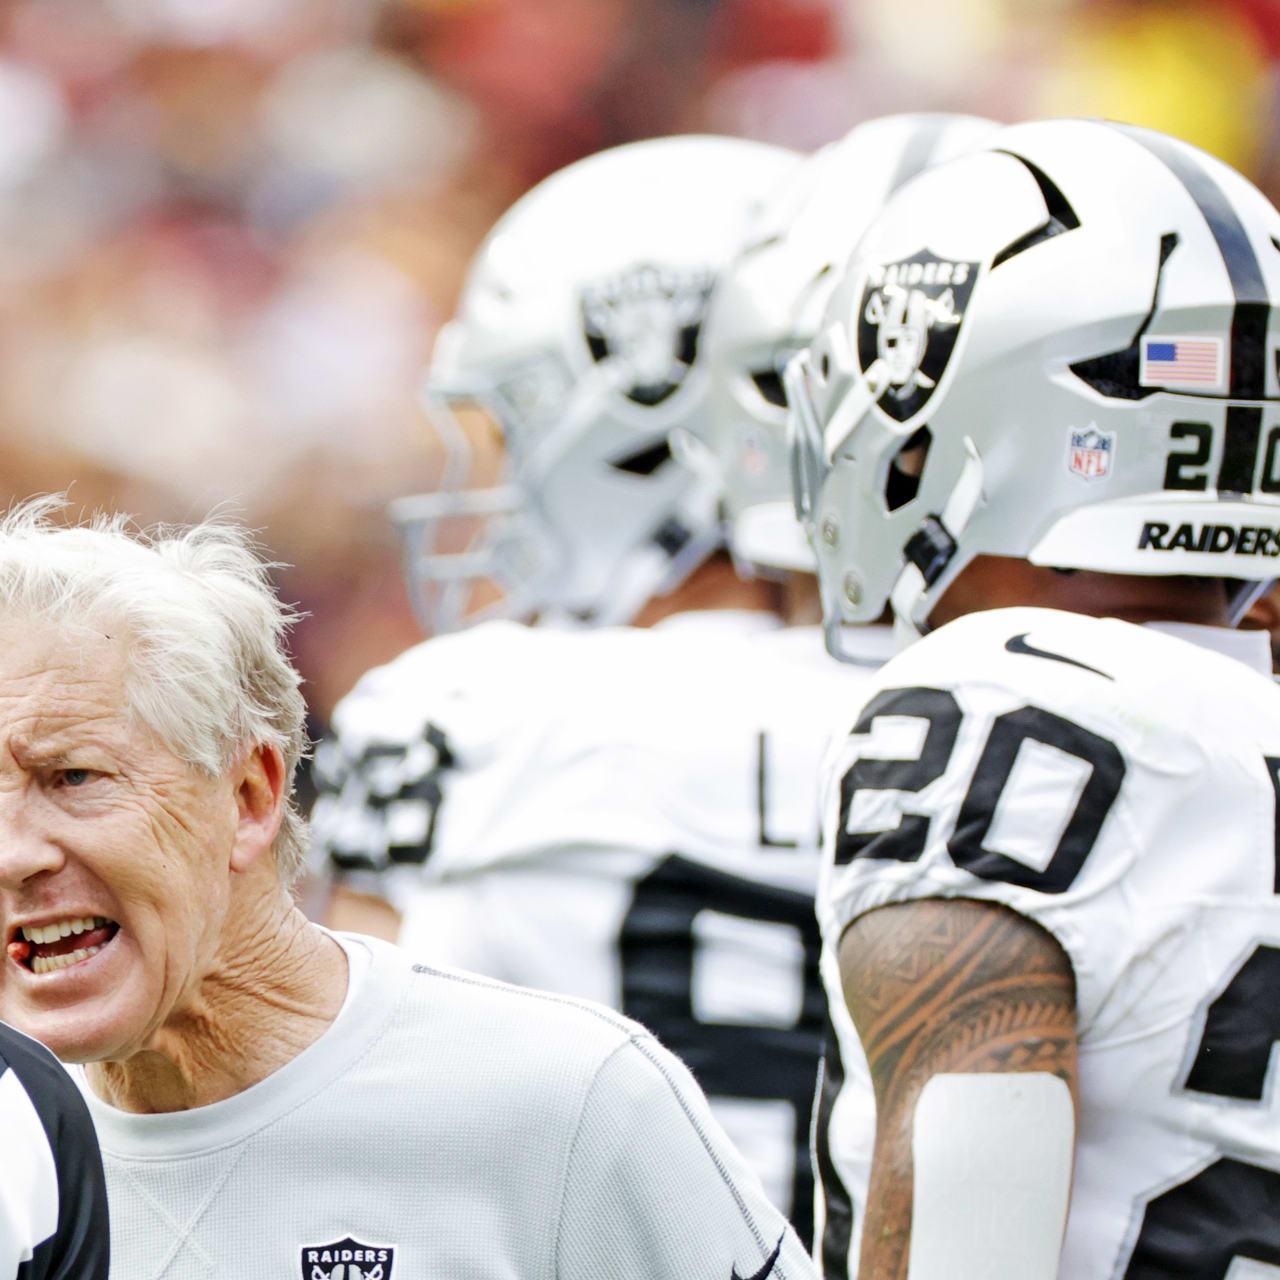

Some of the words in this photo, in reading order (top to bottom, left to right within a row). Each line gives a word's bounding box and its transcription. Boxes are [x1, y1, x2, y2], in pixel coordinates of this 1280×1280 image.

[1072, 451, 1105, 476] NFL
[835, 686, 1126, 893] 20
[307, 1250, 389, 1263] RAIDERS
